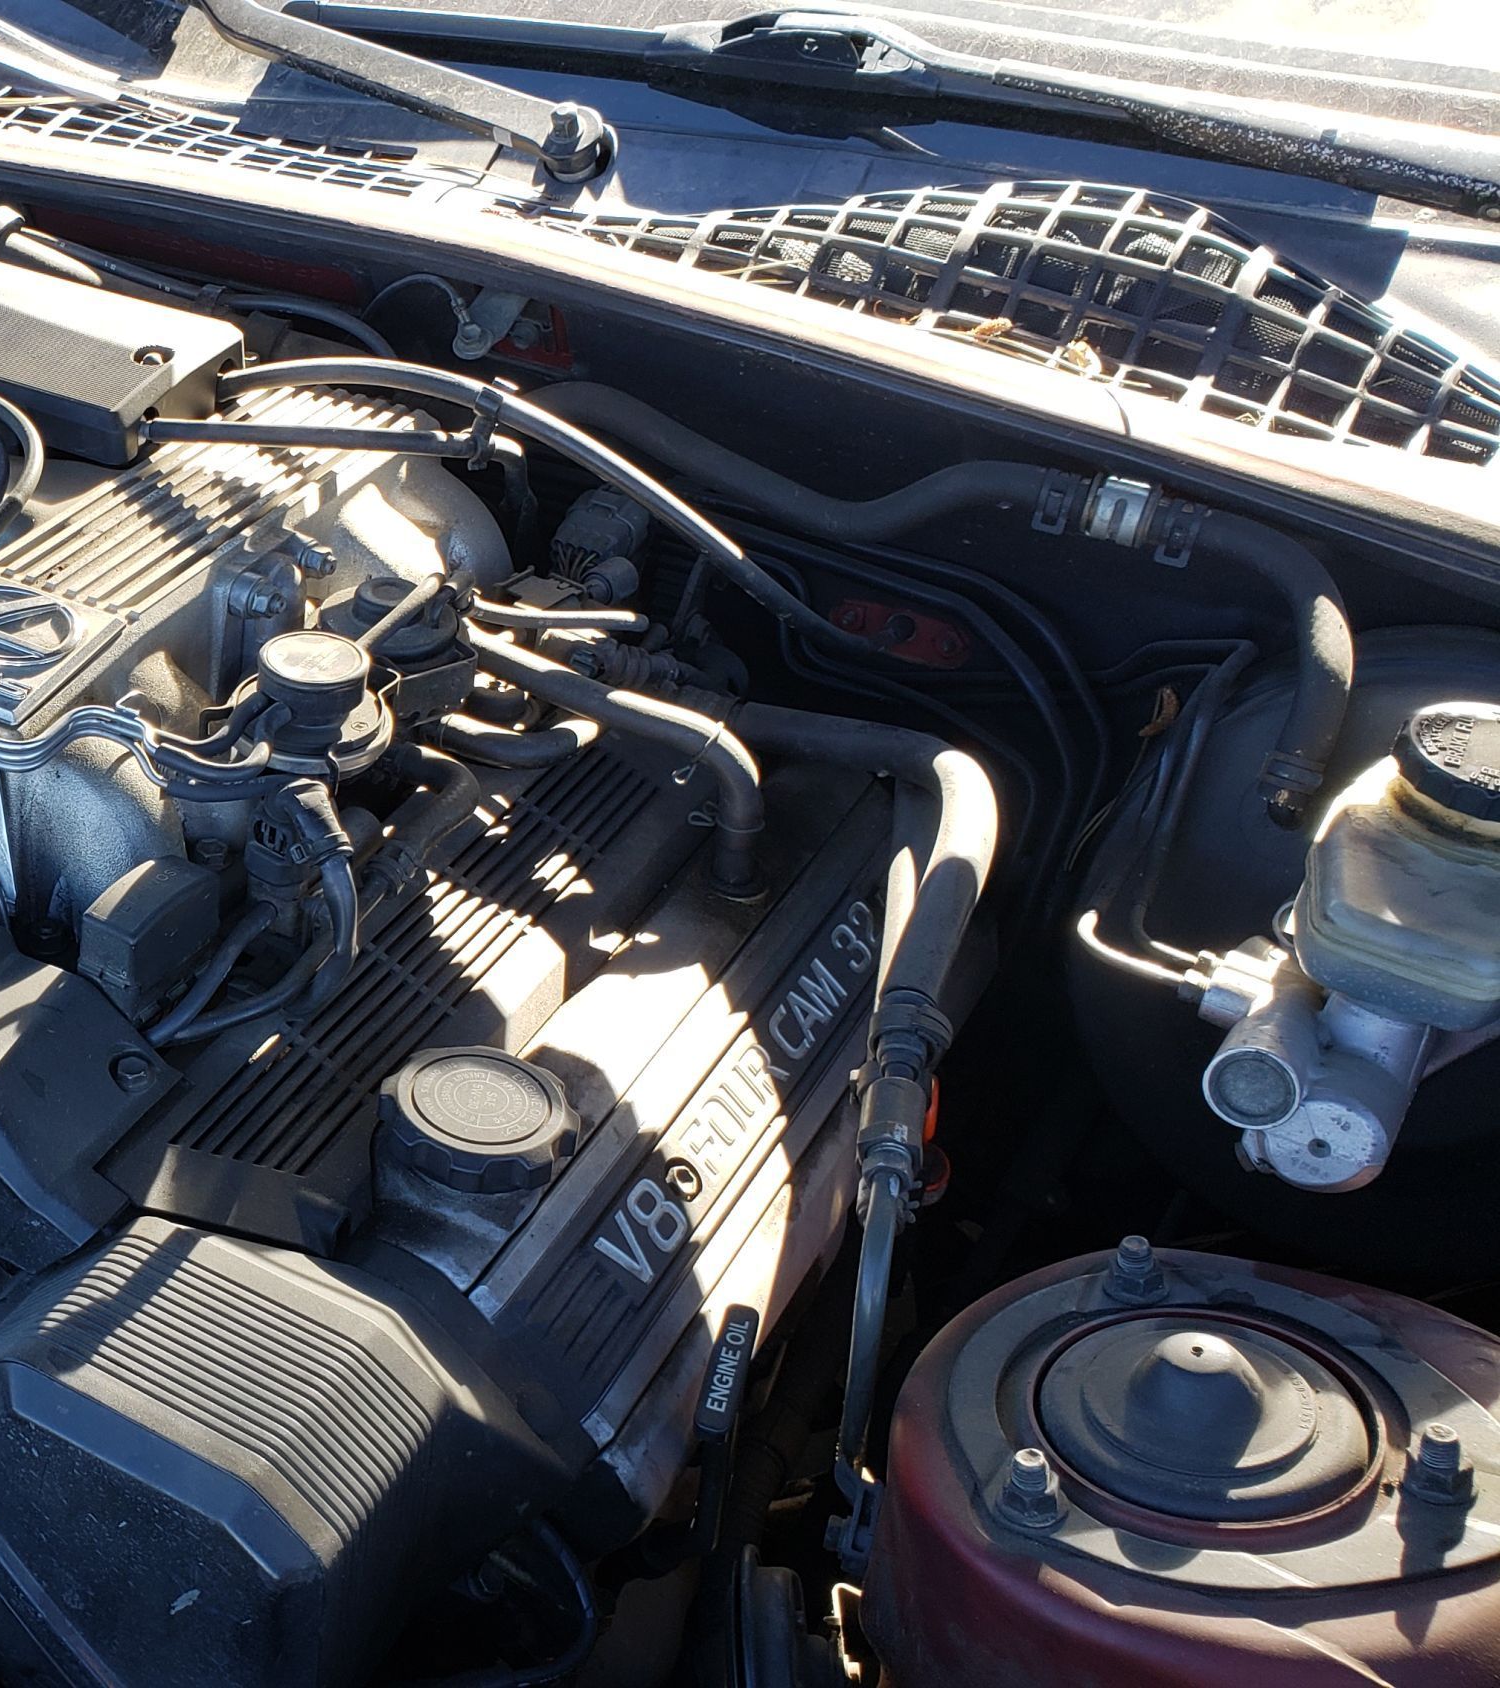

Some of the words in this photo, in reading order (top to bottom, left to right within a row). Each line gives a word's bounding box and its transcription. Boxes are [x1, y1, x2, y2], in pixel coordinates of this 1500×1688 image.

[512, 1072, 543, 1109] ENGINE
[594, 1177, 688, 1284] V8
[768, 957, 848, 1060] CAM
[830, 901, 878, 974] 32
[706, 1347, 741, 1413] ENGINE
[725, 1320, 750, 1345] OIL
